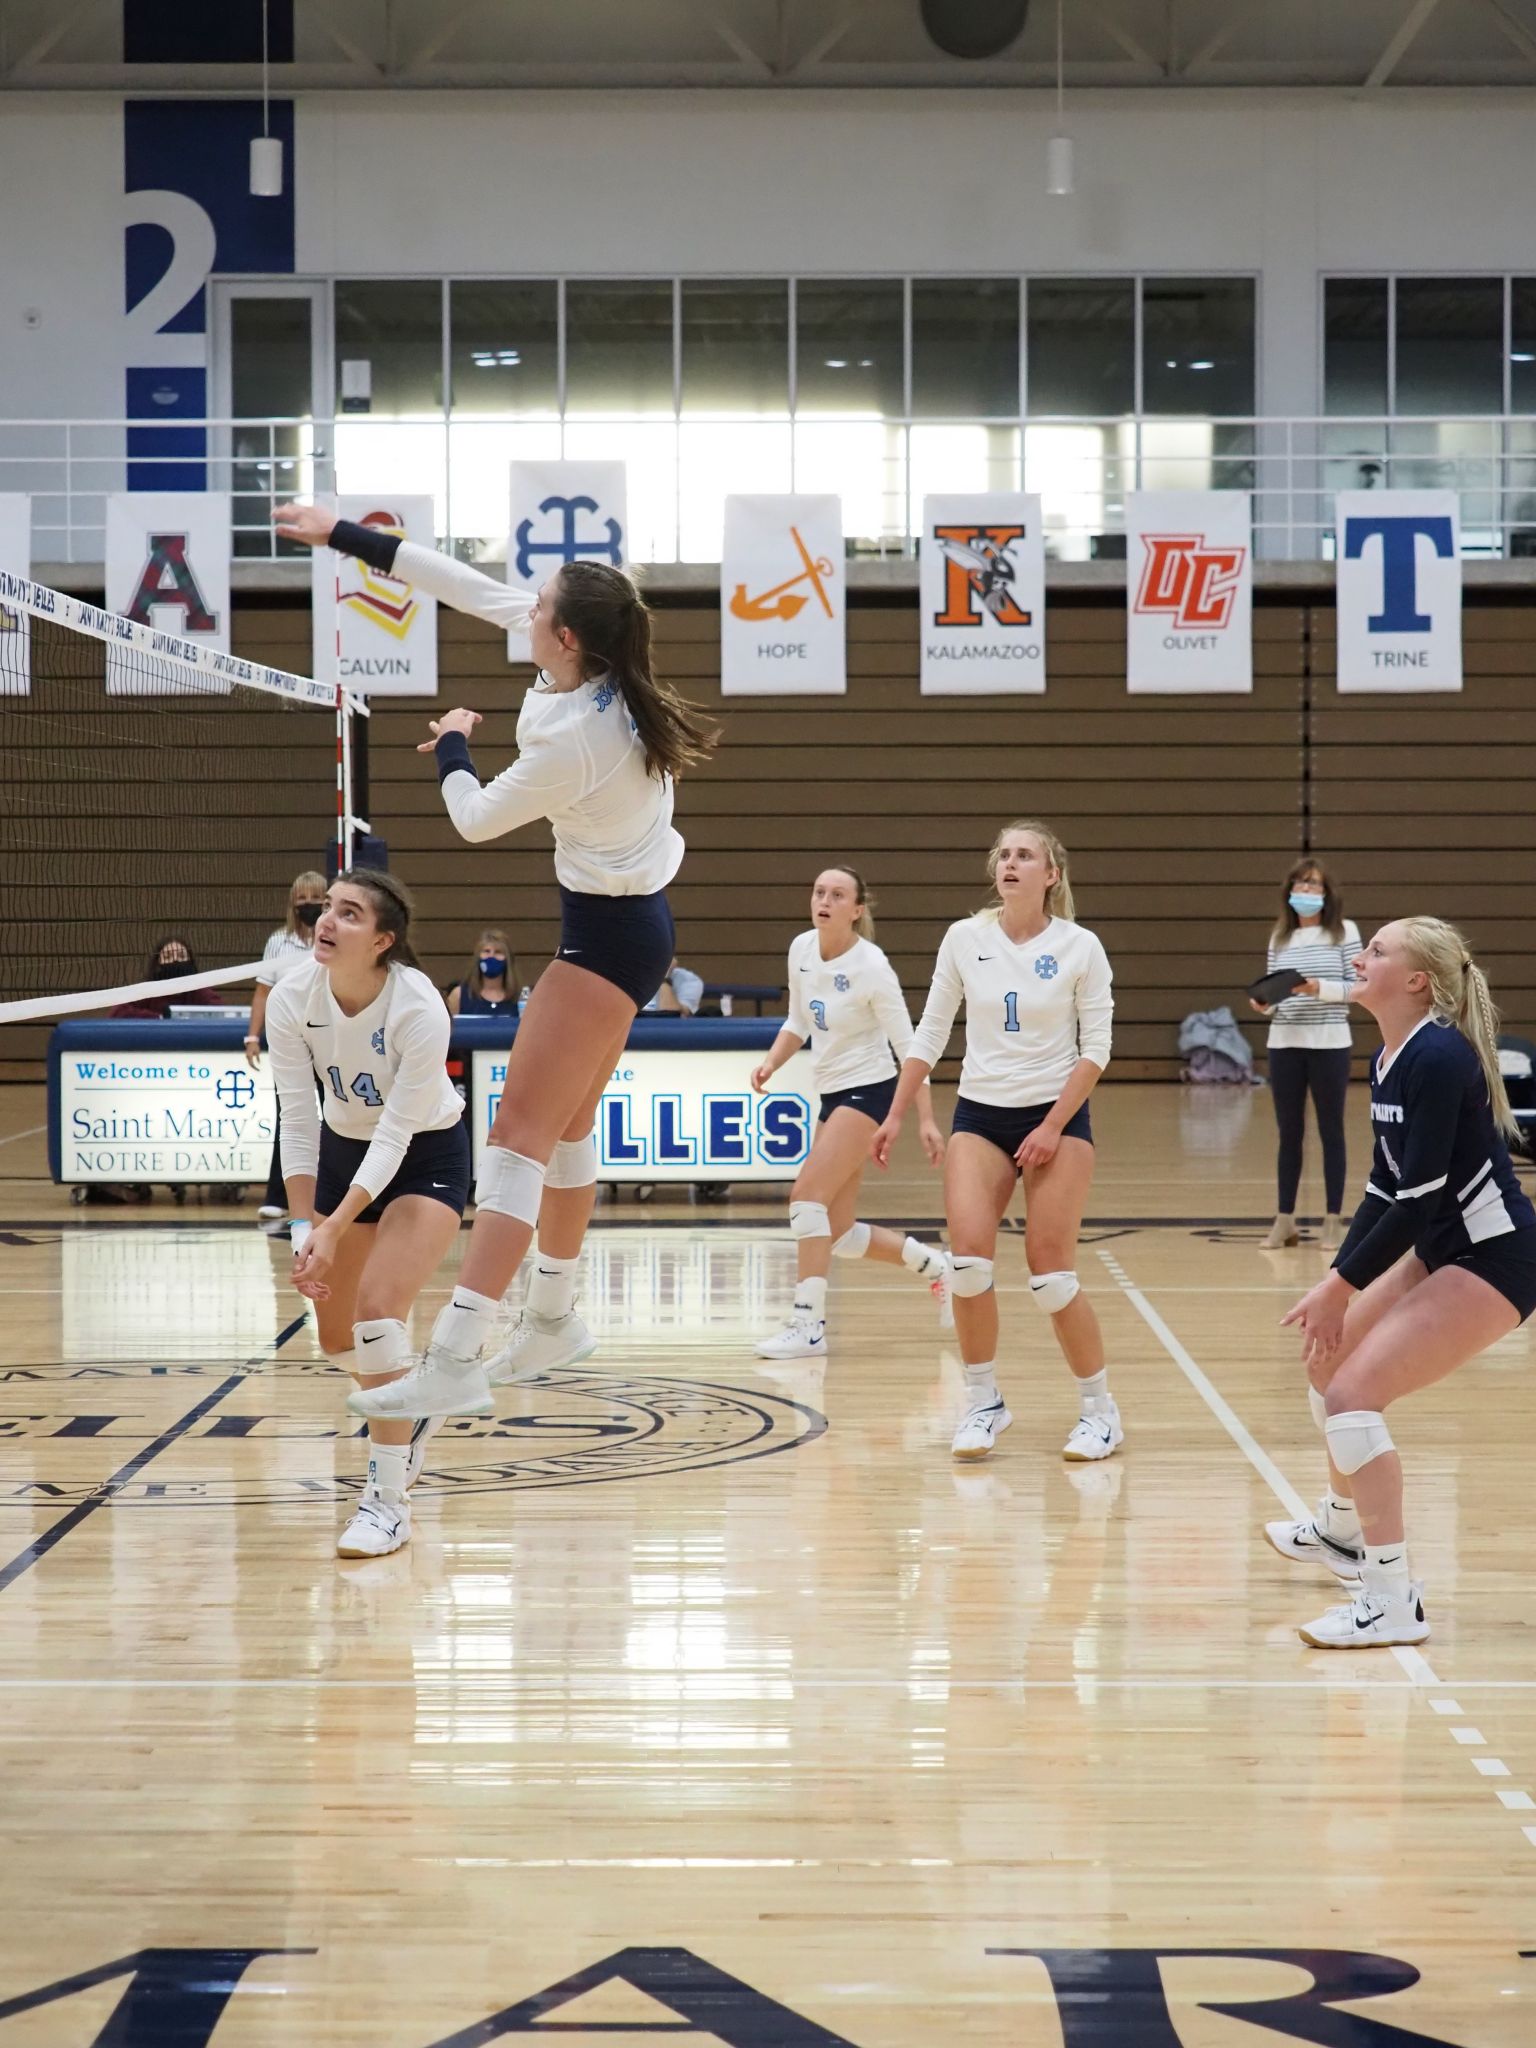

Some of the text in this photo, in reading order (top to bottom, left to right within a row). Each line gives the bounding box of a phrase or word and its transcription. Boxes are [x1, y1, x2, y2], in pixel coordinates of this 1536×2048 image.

[122, 531, 220, 635] A
[933, 524, 1032, 627] K
[1344, 516, 1455, 633] T
[757, 643, 808, 660] HOPE
[926, 643, 1041, 661] KALAMAZOO
[1163, 636, 1219, 651] OLIVET
[338, 658, 411, 676] CALVIN
[1372, 651, 1429, 668] TRINE
[809, 1000, 829, 1031] 3
[1004, 991, 1020, 1031] 1
[75, 1063, 211, 1080] Welcome to
[327, 1065, 385, 1107] 14
[72, 1108, 272, 1150] Saint Mary's
[489, 1093, 810, 1166] LLES
[75, 1151, 253, 1173] NOTRE DAME
